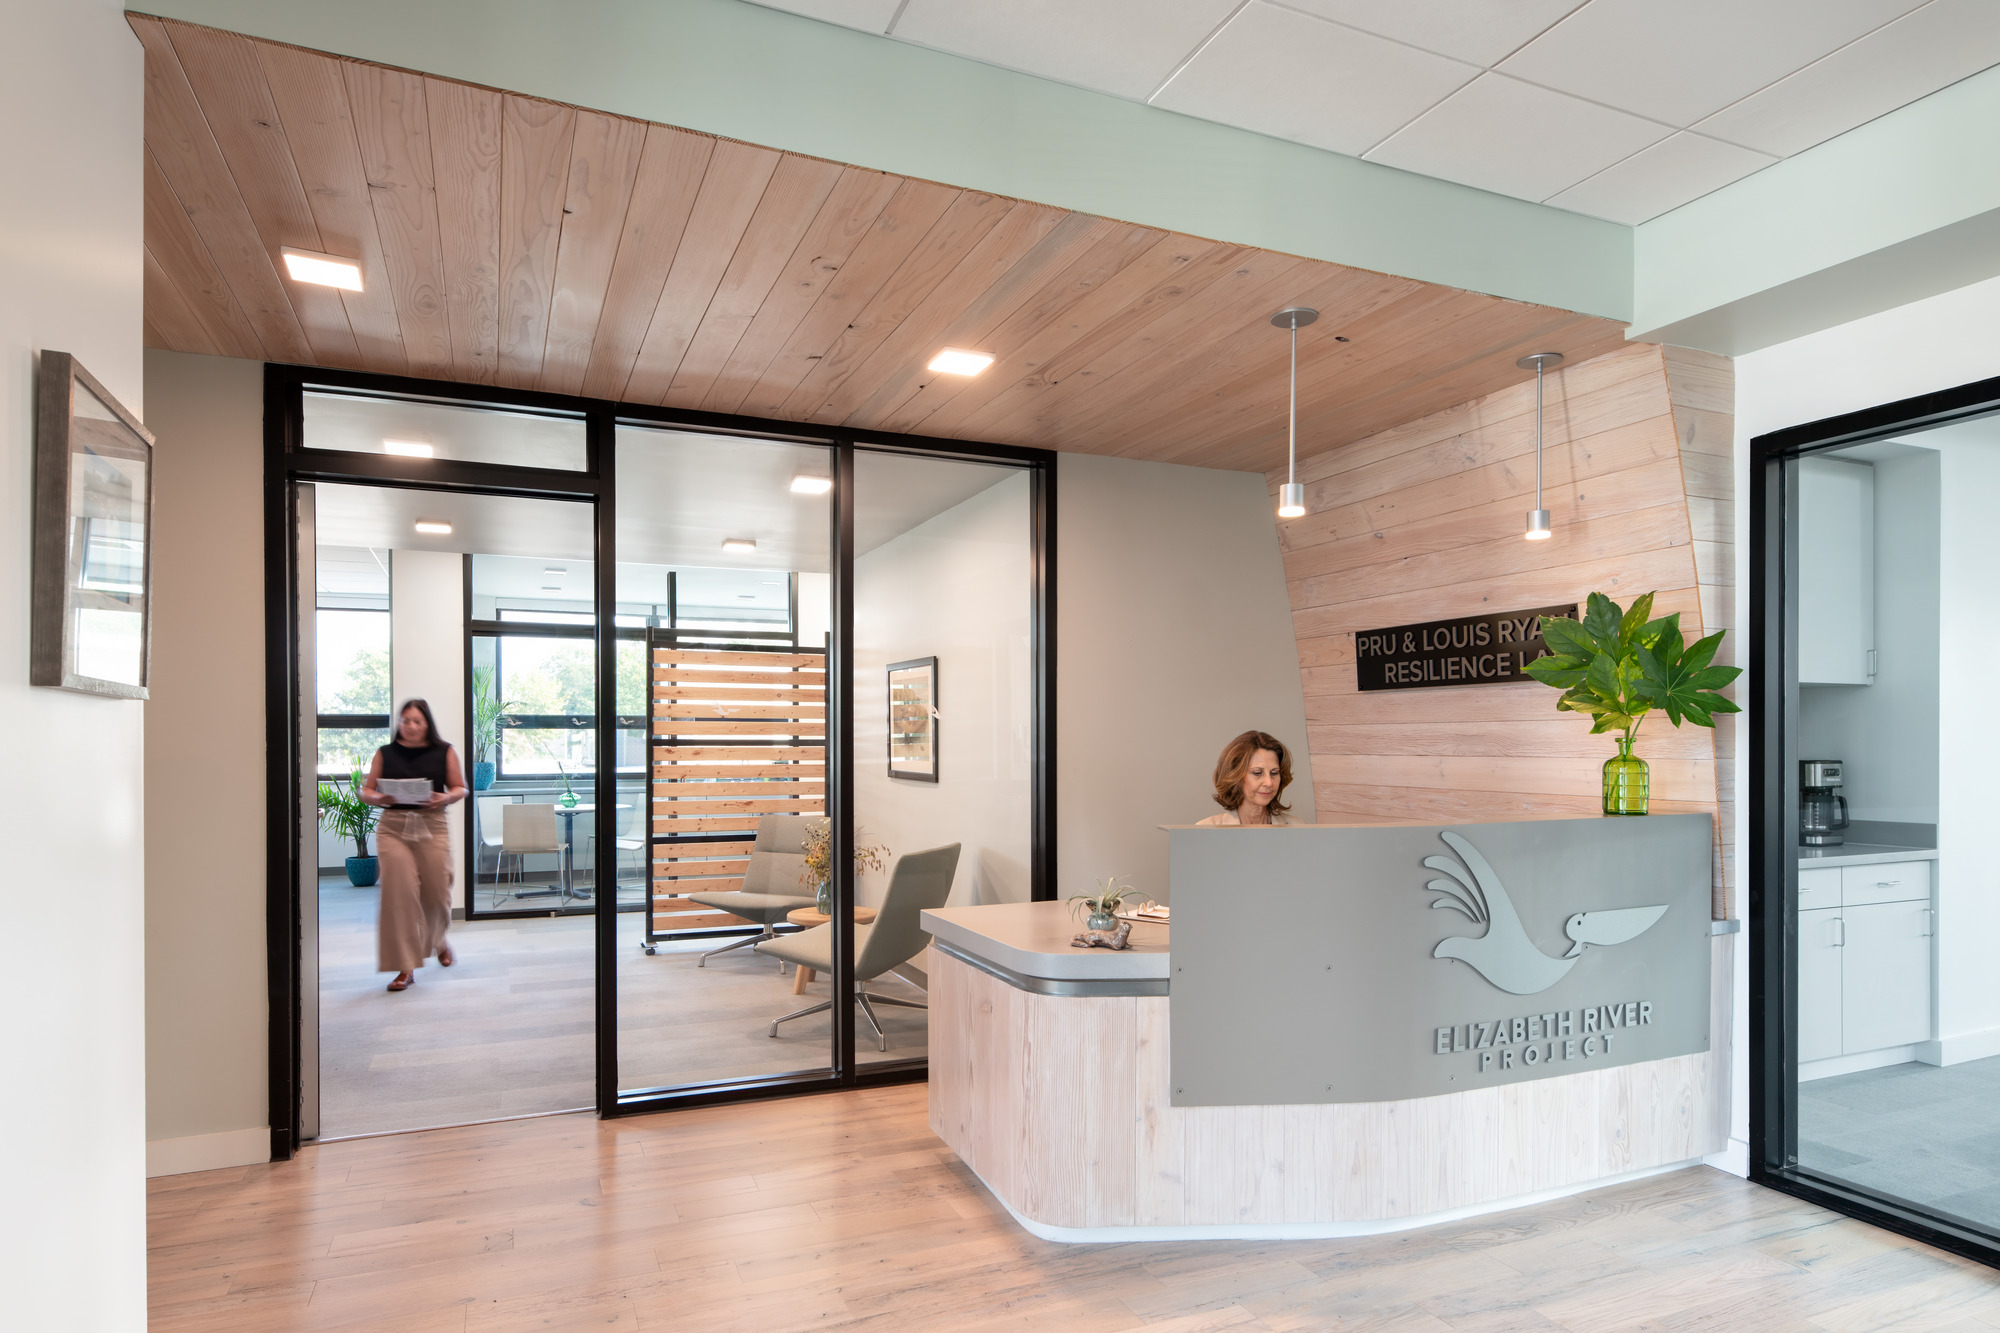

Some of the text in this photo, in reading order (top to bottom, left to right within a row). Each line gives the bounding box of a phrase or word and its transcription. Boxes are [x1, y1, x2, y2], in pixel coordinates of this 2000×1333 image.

[1358, 612, 1570, 657] PRU & LOUIS RYA
[1385, 652, 1511, 684] RESILIENCE
[1436, 1001, 1653, 1054] ELIZABETH RIVER
[1480, 1034, 1615, 1073] PROJECT
